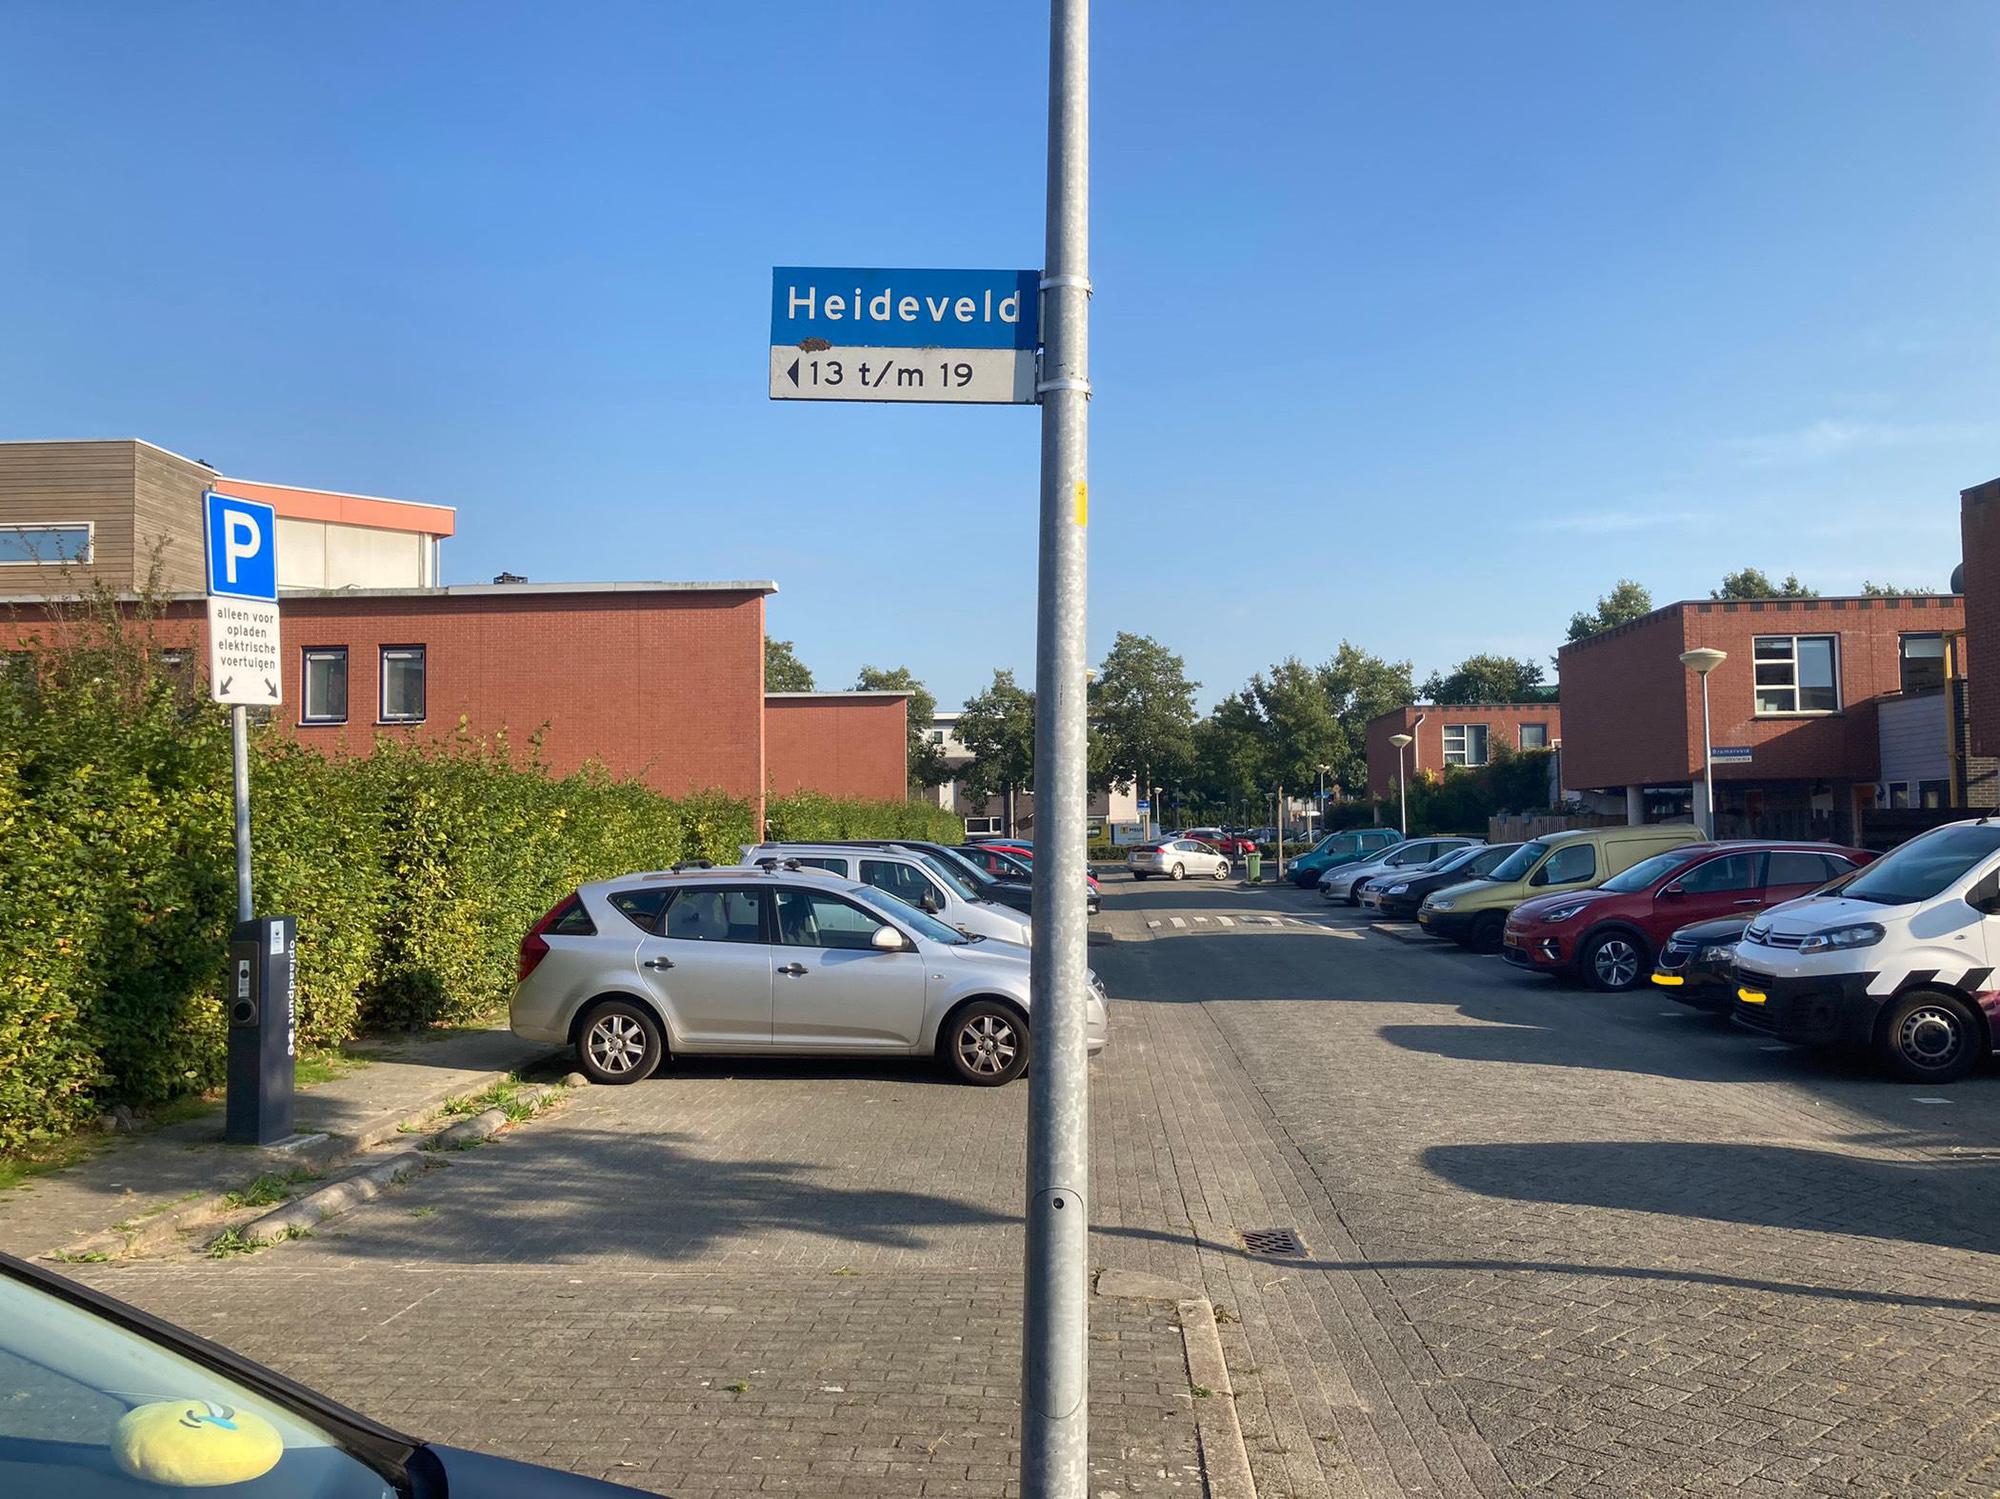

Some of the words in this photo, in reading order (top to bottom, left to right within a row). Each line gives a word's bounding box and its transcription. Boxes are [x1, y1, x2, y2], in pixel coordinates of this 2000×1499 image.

[788, 286, 1020, 323] Heideveld
[810, 361, 843, 386] 13
[859, 360, 924, 387] t/m
[940, 362, 973, 387] 19
[223, 508, 262, 584] P
[217, 607, 249, 622] alleen
[252, 612, 274, 624] voor
[227, 625, 267, 639] opladen
[218, 639, 276, 655] elektrische
[220, 655, 276, 671] voertuigen
